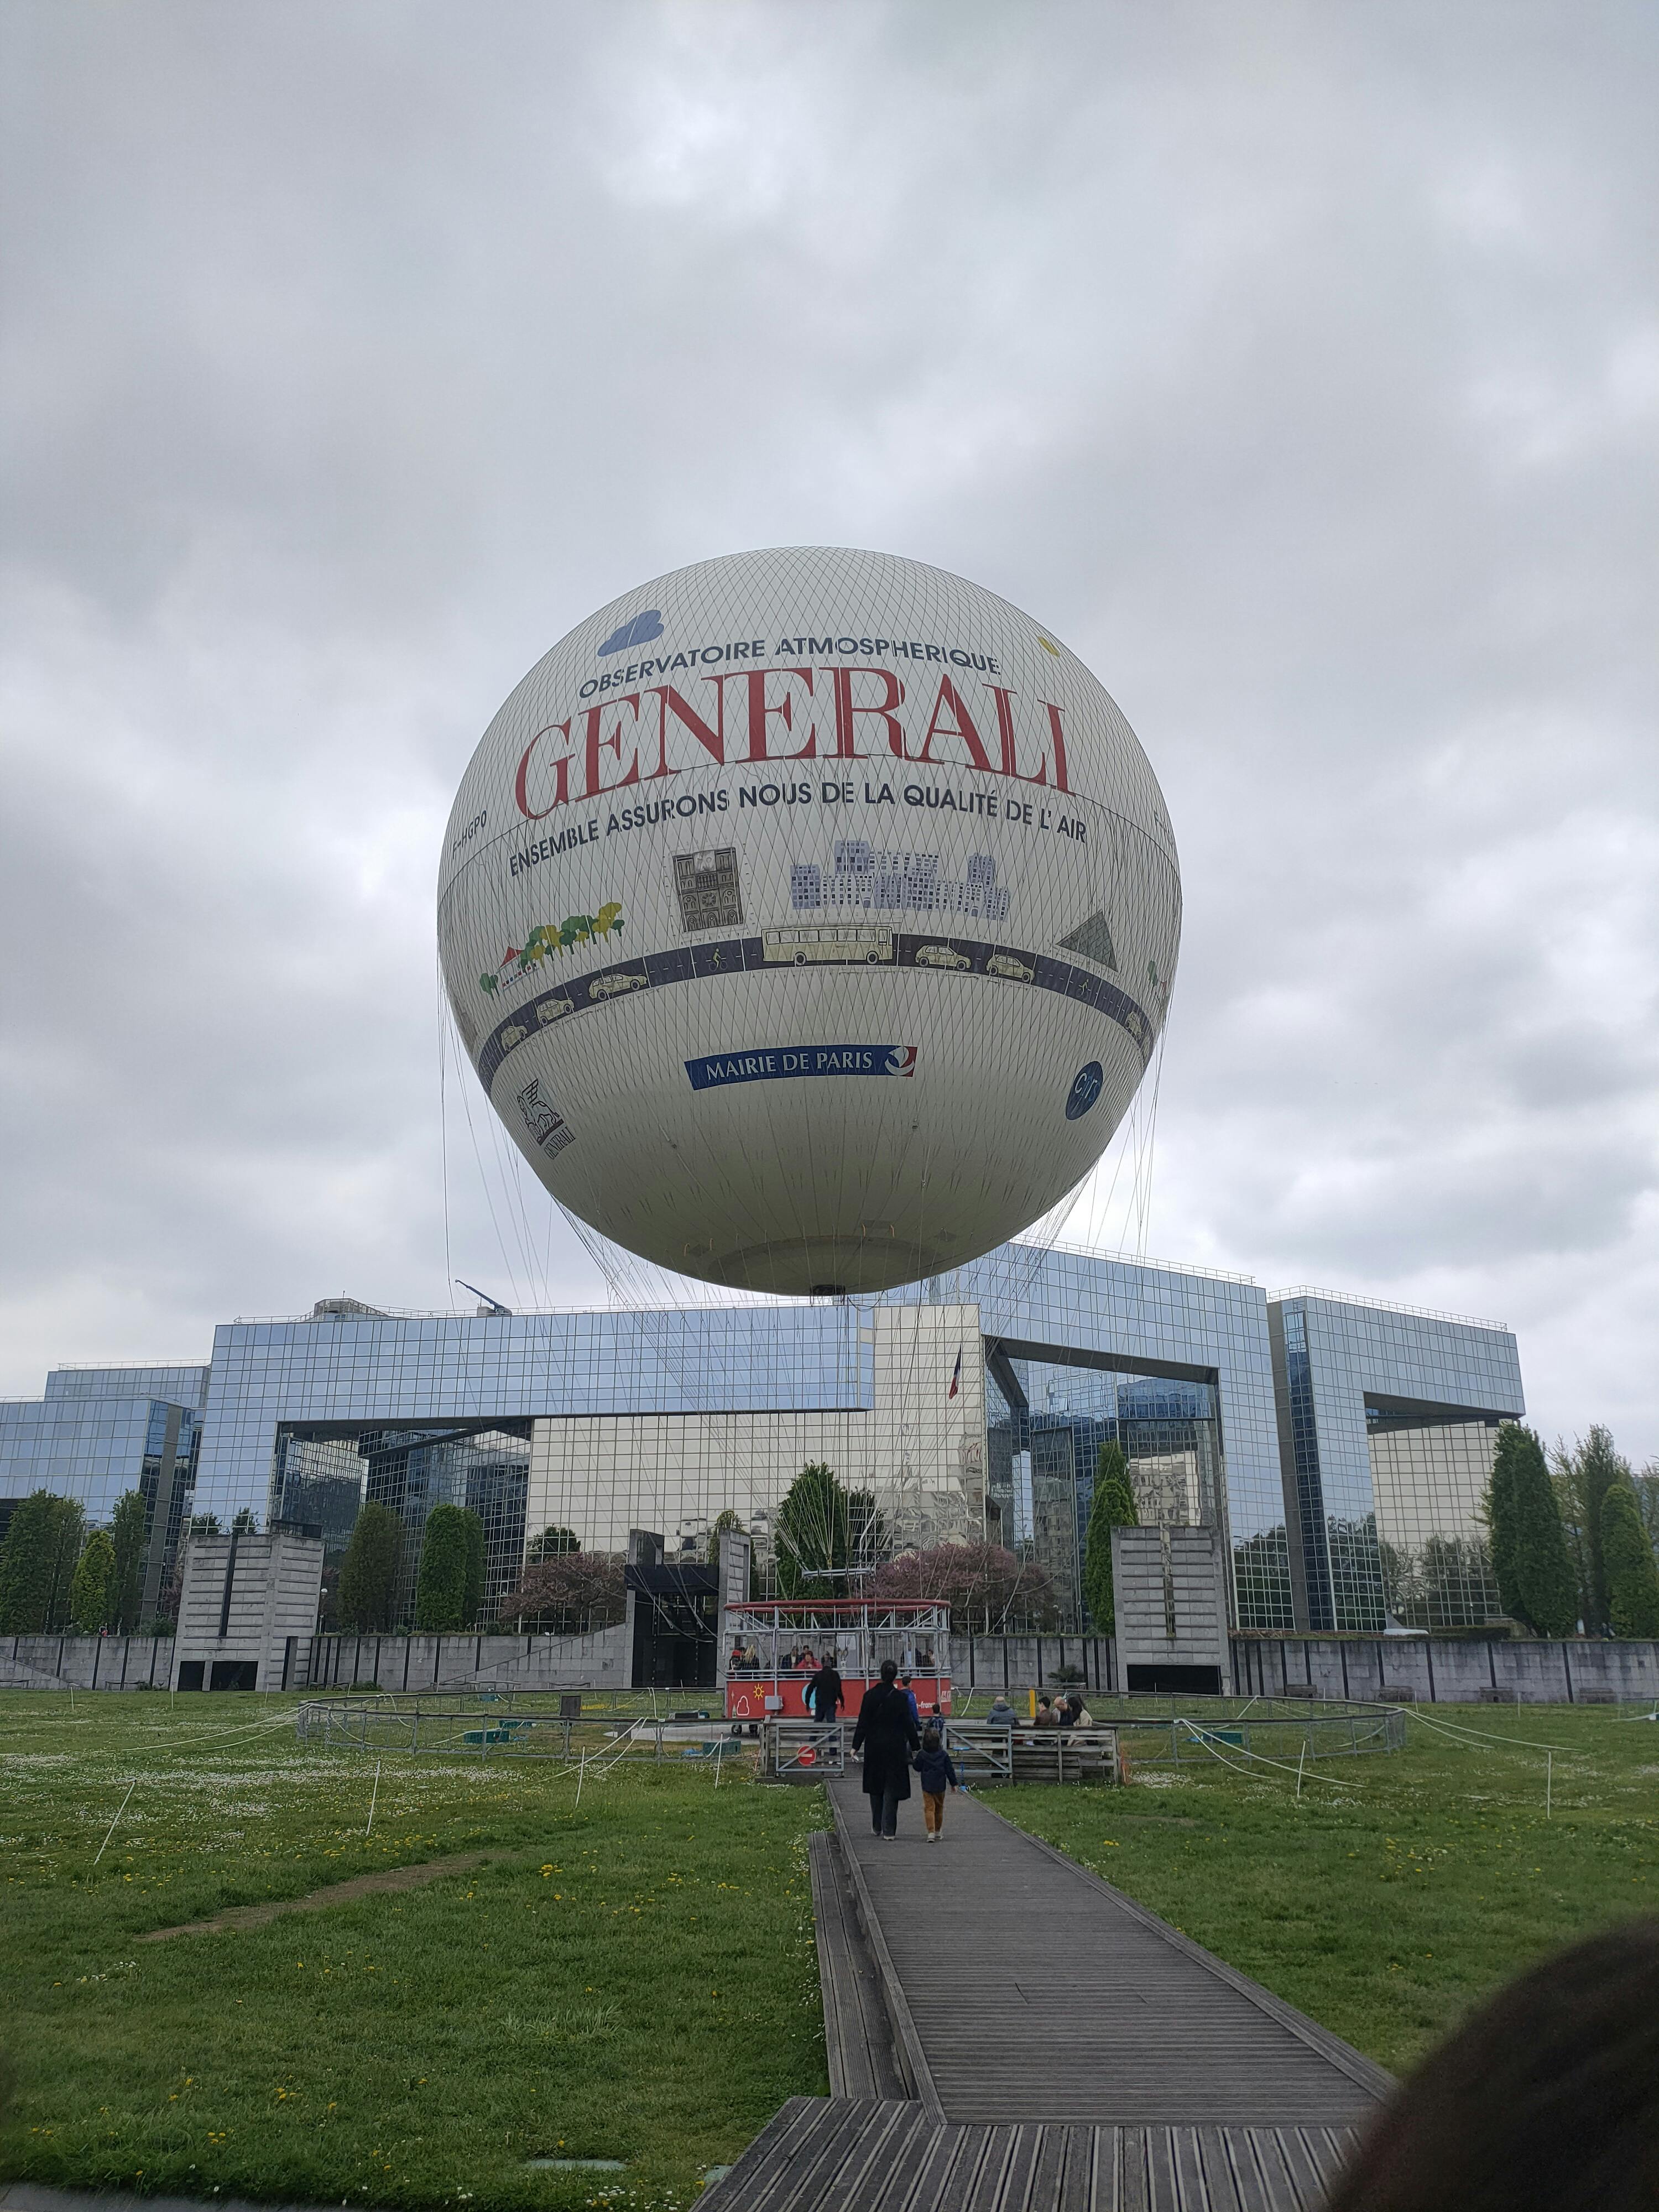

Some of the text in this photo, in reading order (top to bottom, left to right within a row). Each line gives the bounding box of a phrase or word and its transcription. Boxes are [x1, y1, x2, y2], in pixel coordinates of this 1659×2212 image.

[580, 637, 1000, 698] OBSERVATOIRE ATMOSPHERIQUE
[515, 667, 1076, 820] GENERALI
[509, 819, 599, 877] ENSEMBLE
[607, 789, 729, 836] ASSURONS
[739, 782, 811, 807] NOUS
[822, 782, 854, 803] DE
[865, 782, 895, 804] LA
[904, 784, 997, 817] QUALITÉ
[1006, 800, 1032, 825] DE
[1057, 815, 1086, 843] AIR
[706, 1052, 873, 1080] MAIRIE DE PARIS
[544, 1126, 576, 1160] GENERALI
